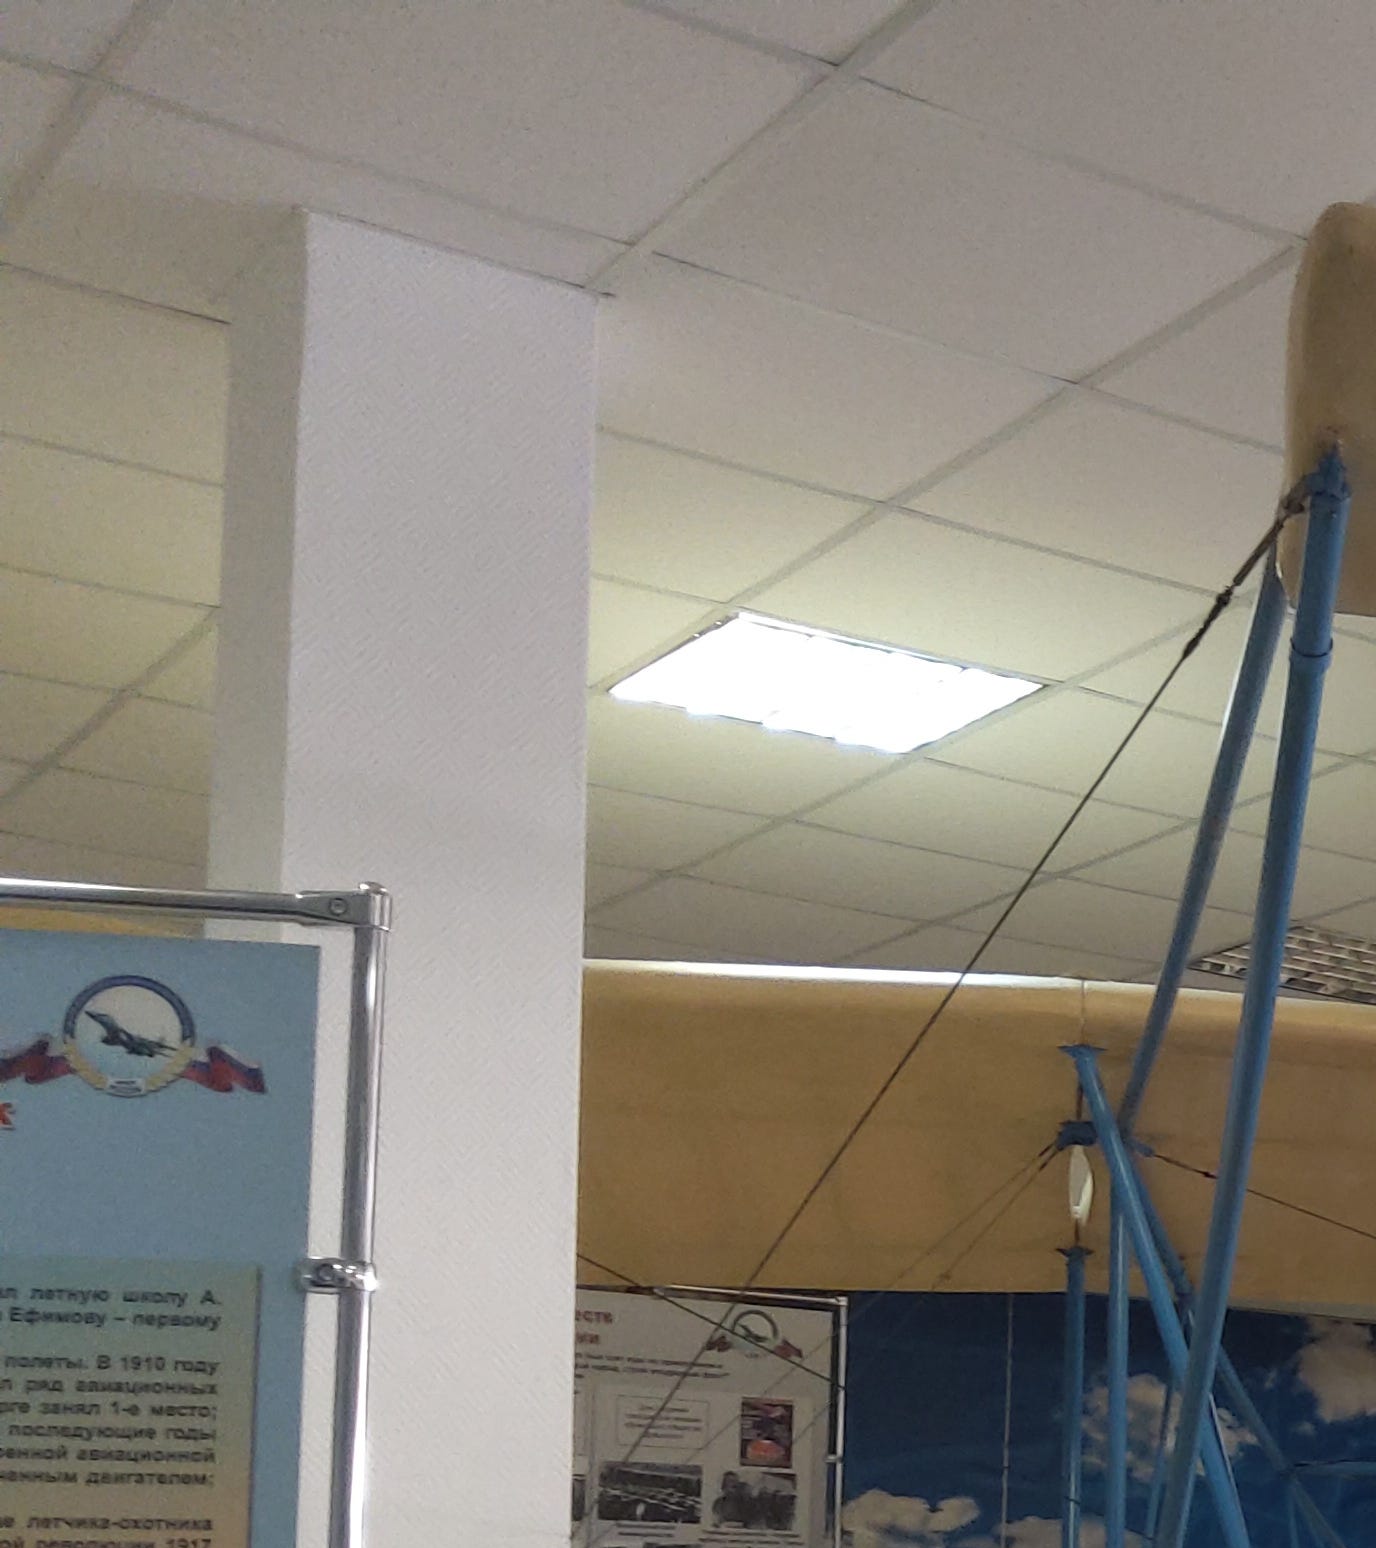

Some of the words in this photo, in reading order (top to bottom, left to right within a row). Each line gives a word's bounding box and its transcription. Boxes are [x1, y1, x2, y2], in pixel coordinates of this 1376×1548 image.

[31, 1287, 110, 1304] летную
[122, 1289, 188, 1308] школу
[9, 1307, 106, 1327] Ефимову
[132, 1313, 221, 1331] первому
[97, 1355, 110, 1369] В
[121, 1355, 166, 1371] 1910
[174, 1359, 220, 1375] году
[26, 1380, 63, 1394] ряд
[76, 1380, 218, 1395] авиационных
[40, 1403, 100, 1415] занял
[111, 1401, 140, 1416] 1-е
[8, 1424, 156, 1441] последующие
[166, 1427, 215, 1441] годы
[77, 1447, 214, 1462] авиационной
[27, 1516, 212, 1530] летчика-охотника
